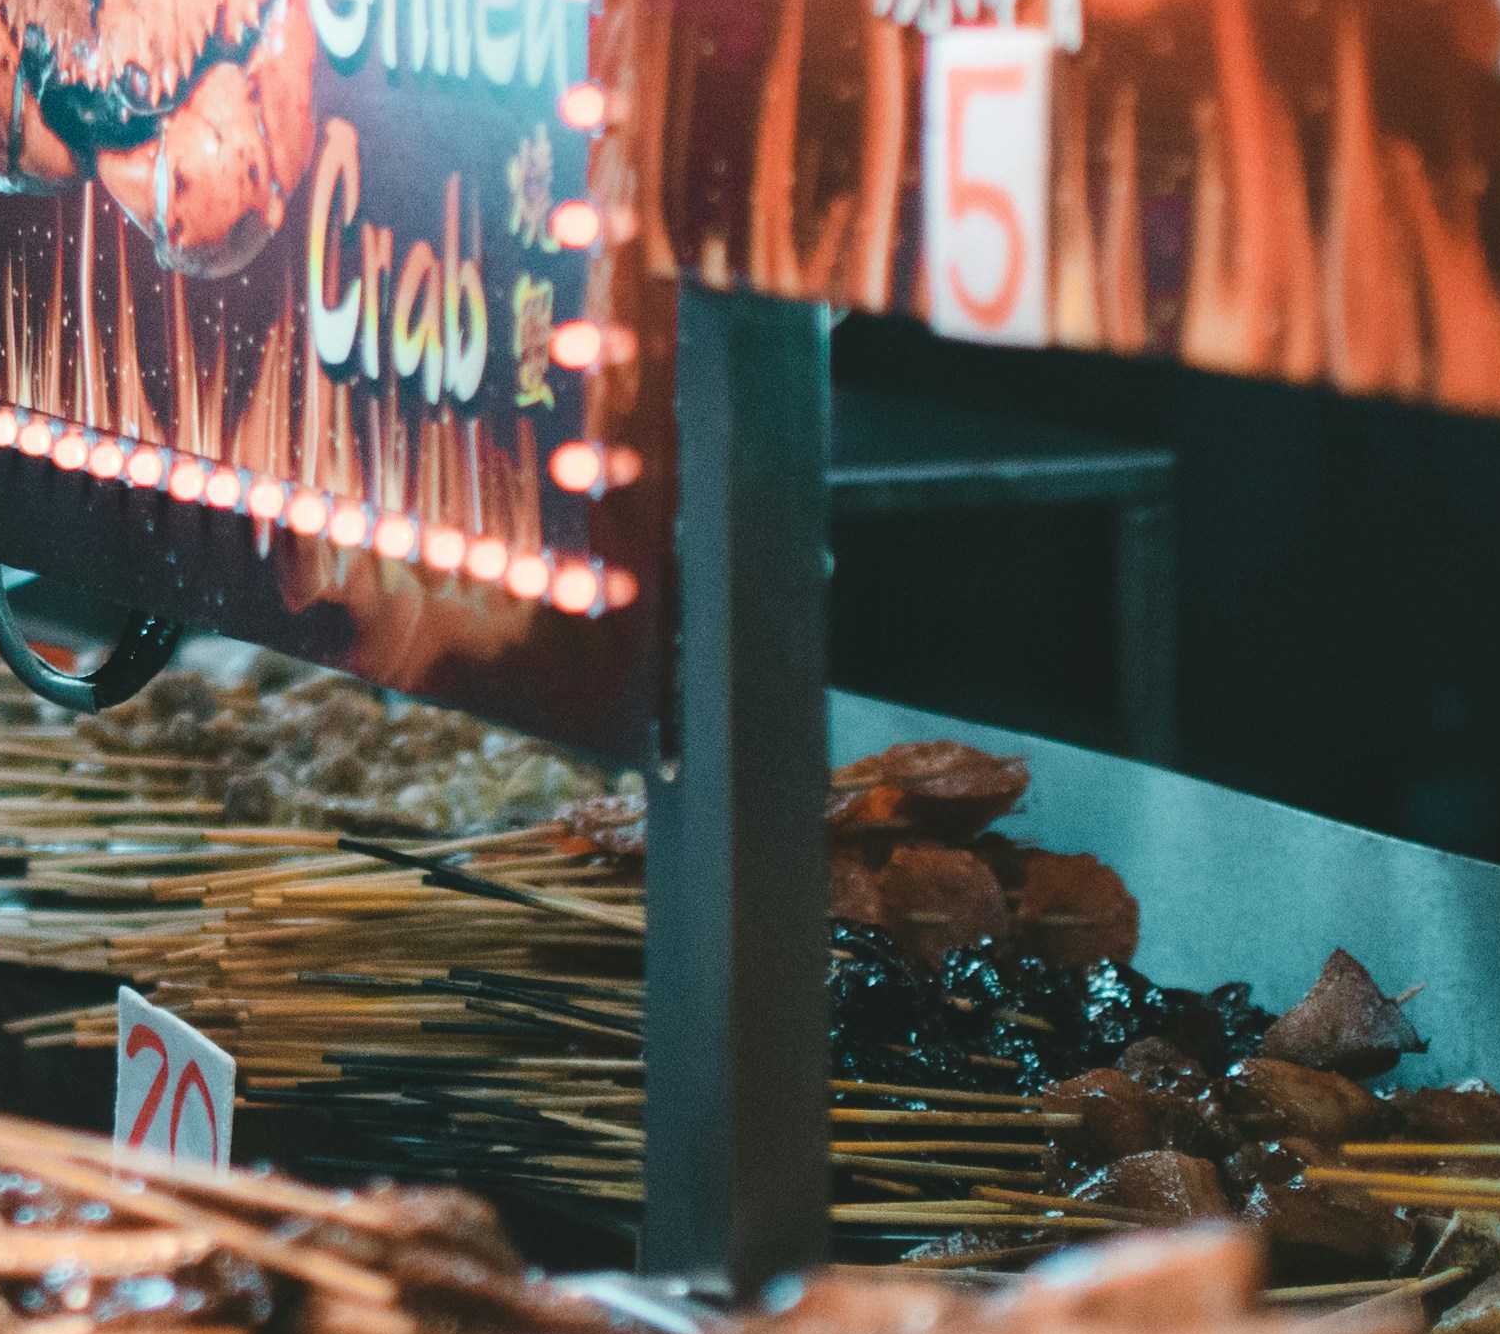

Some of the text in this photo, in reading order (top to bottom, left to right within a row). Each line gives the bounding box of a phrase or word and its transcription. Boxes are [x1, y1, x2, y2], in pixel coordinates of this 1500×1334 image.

[308, 117, 489, 405] Crab
[944, 65, 1028, 333] 5
[125, 1022, 218, 1169] 20
